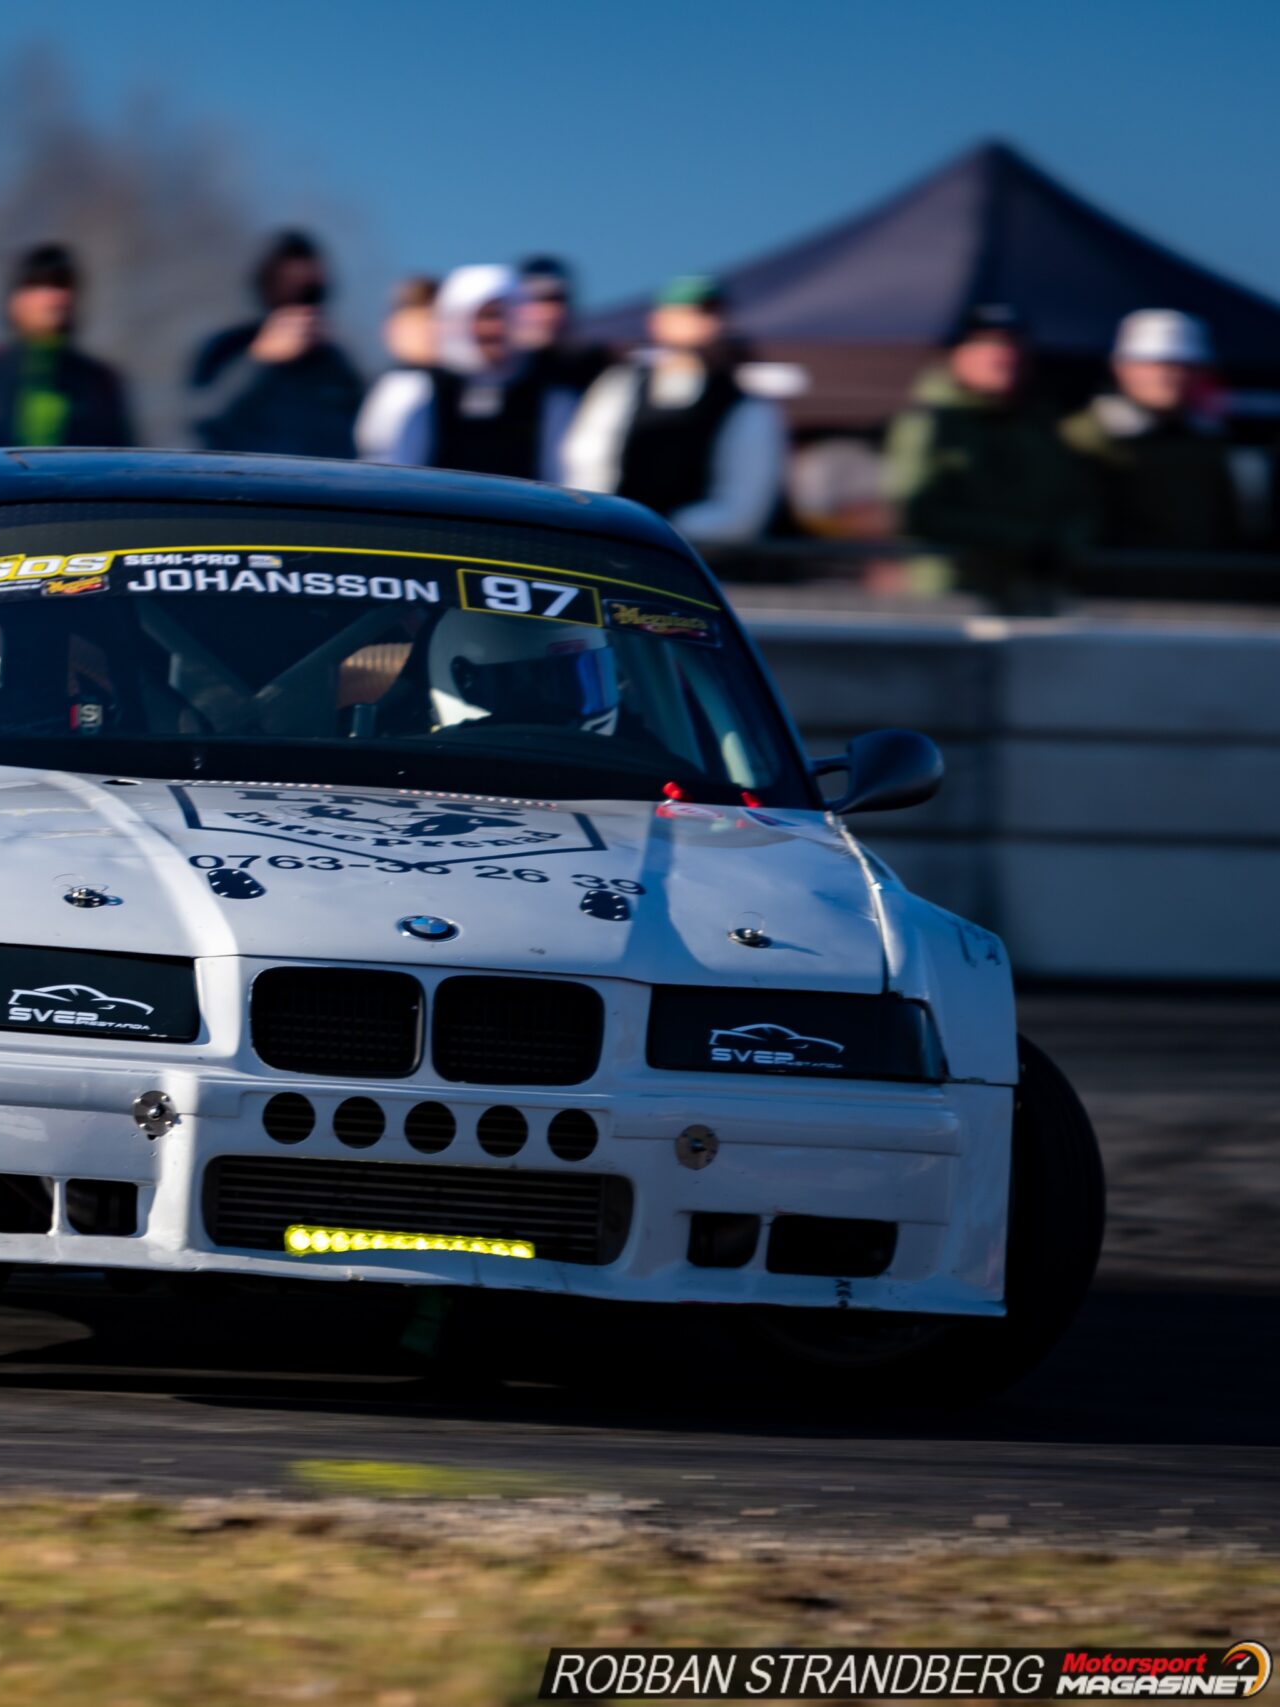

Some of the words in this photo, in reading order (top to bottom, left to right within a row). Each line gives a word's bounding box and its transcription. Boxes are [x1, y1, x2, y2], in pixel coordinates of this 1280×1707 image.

[124, 553, 241, 567] SEMI-PRO
[127, 569, 440, 603] JOHANSSON
[481, 575, 580, 617] 97
[234, 790, 524, 816] LNC
[224, 811, 562, 848] Entreprenad
[188, 854, 452, 875] 0763-36
[473, 865, 551, 883] 26
[571, 874, 648, 896] 39
